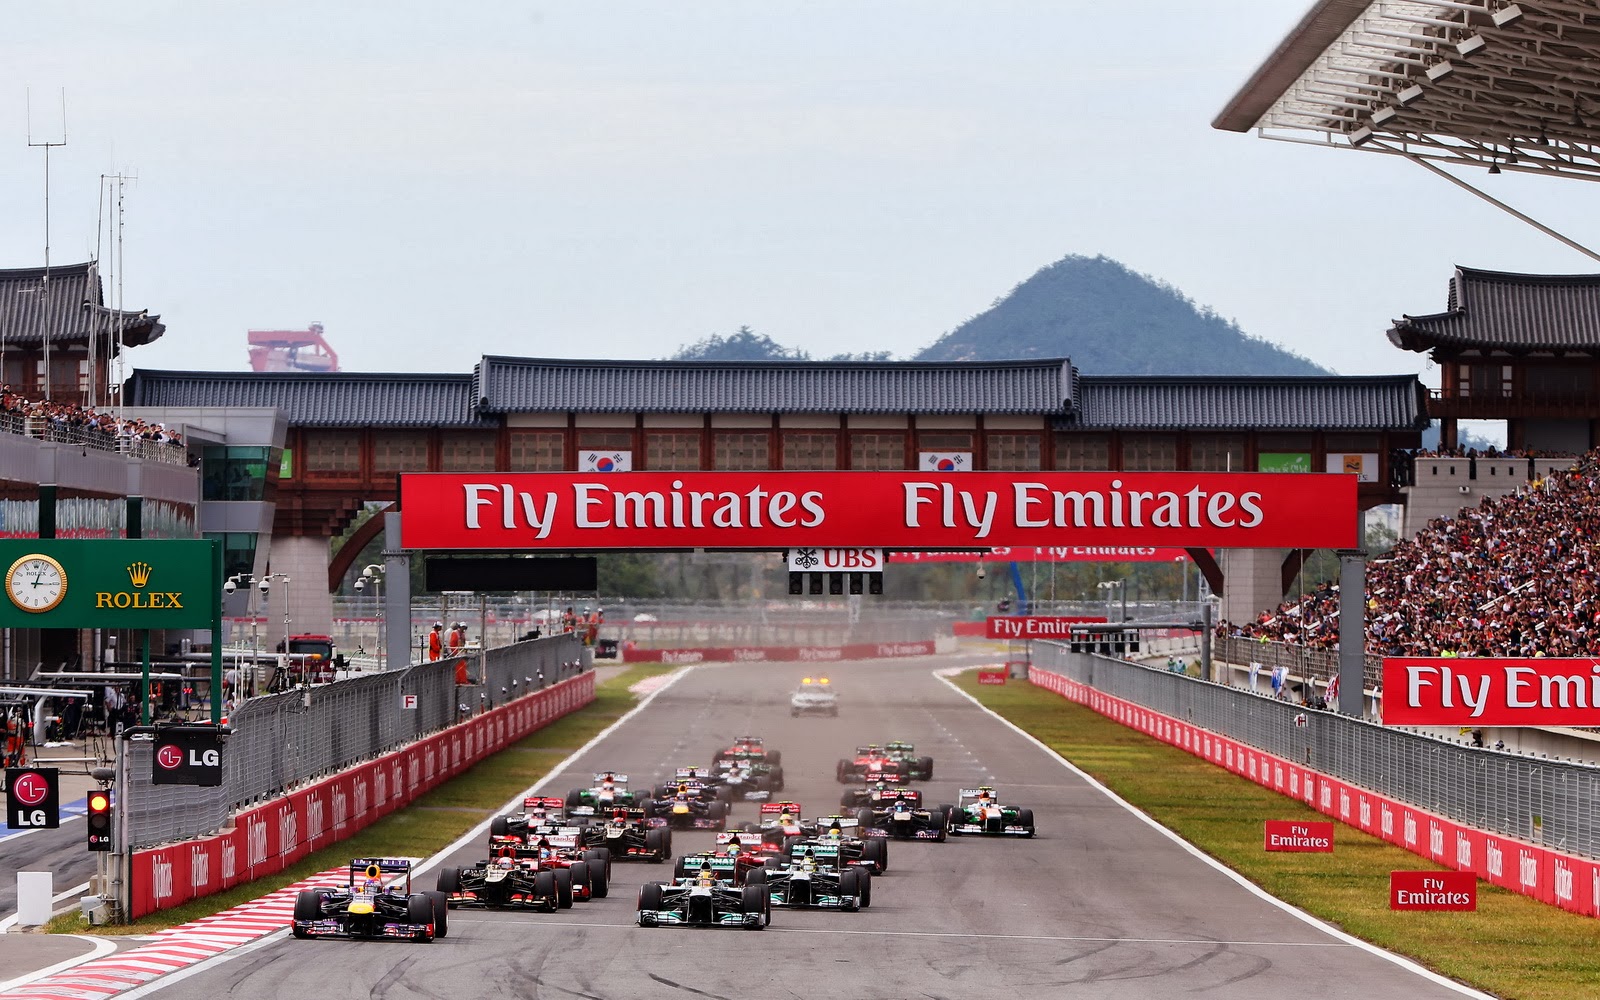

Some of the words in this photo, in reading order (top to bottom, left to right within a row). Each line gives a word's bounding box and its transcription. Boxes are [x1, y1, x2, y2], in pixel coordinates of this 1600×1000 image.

[463, 483, 558, 539] Fly
[572, 480, 825, 529] Emirates
[903, 482, 998, 539] Fly
[1012, 480, 1264, 529] Emirates
[822, 548, 877, 568] UBS
[95, 592, 184, 608] ROLEX
[994, 619, 1023, 637] Fly
[1406, 666, 1491, 717] Fly
[1504, 664, 1600, 708] Emi
[405, 696, 415, 708] F
[189, 749, 219, 766] LG
[18, 810, 47, 826] LG
[1291, 826, 1308, 836] Fly
[1271, 834, 1329, 848] Emirates
[1423, 879, 1444, 890] Fly
[1397, 889, 1470, 905] Emirates
